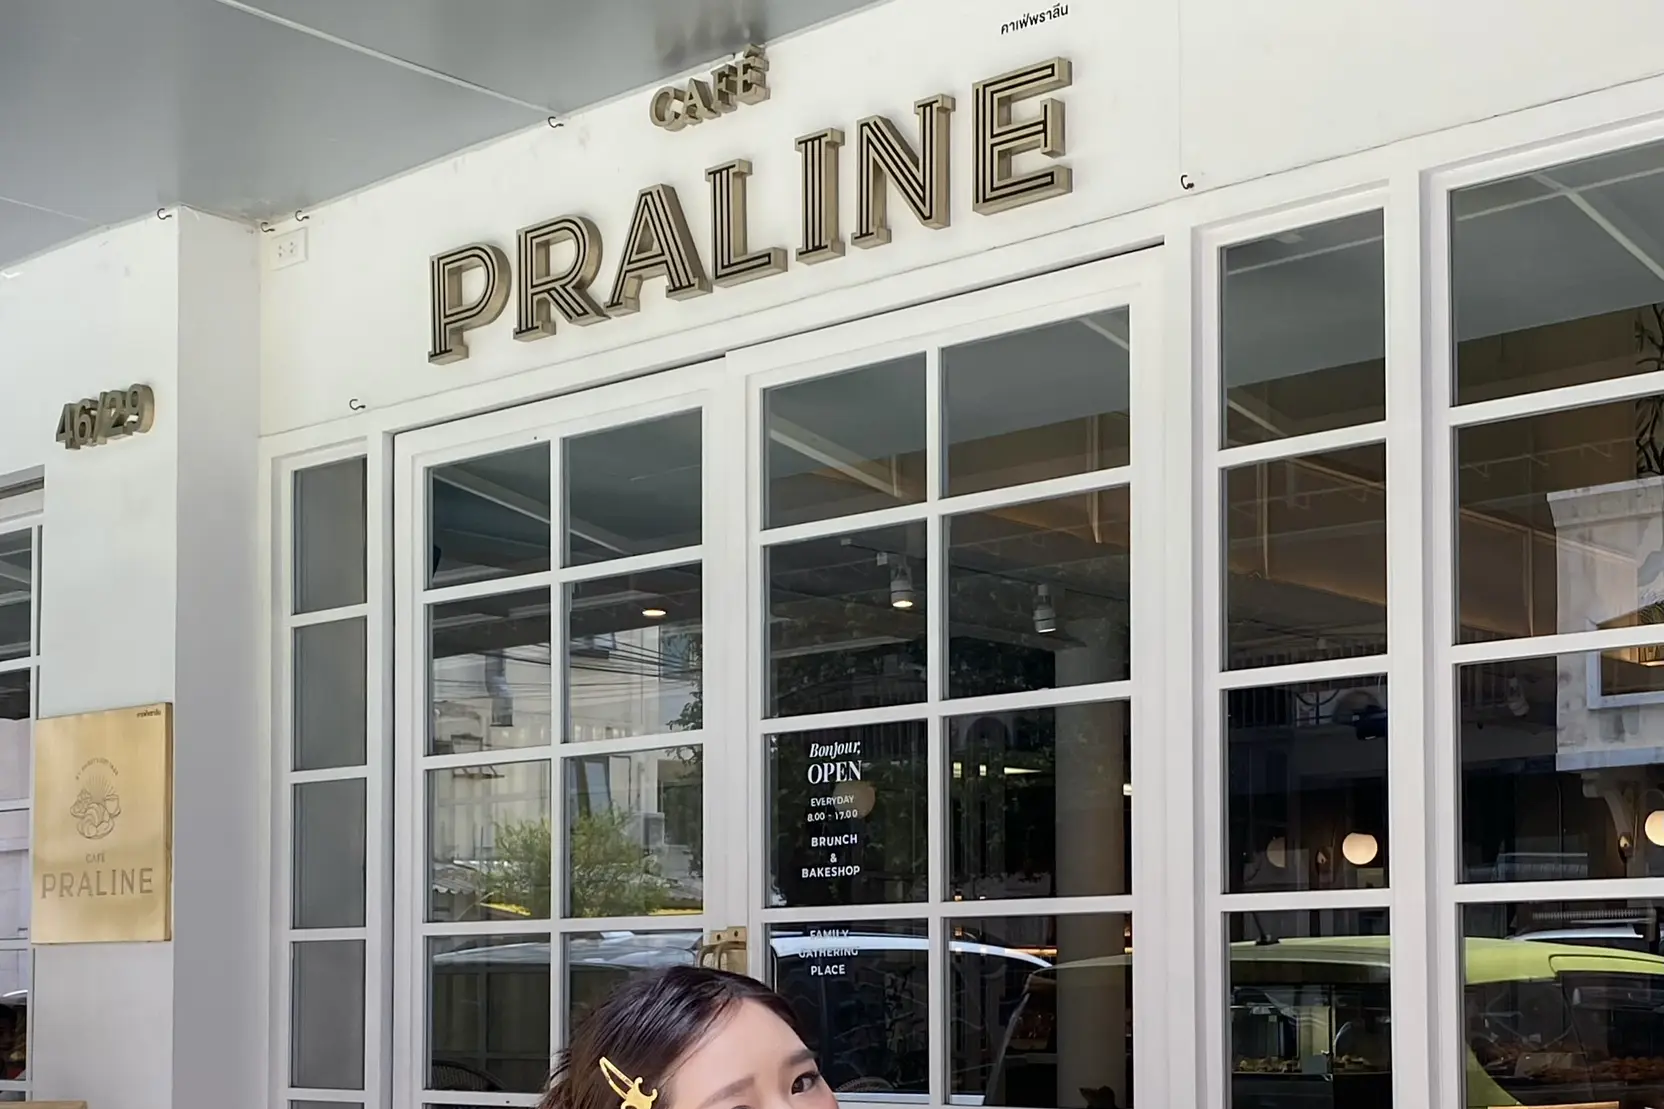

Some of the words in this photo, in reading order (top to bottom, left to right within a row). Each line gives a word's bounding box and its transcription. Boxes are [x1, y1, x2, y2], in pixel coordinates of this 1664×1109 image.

[649, 43, 771, 132] CAFÉ
[428, 57, 1073, 365] PRALINE
[56, 383, 155, 450] 46/29
[809, 741, 861, 759] Bonjour,
[807, 760, 862, 784] OPEN
[810, 795, 855, 807] EVERYDAY
[807, 812, 826, 822] 8.00
[834, 809, 858, 820] 17.00
[811, 834, 858, 847] BRUNCH
[830, 853, 837, 863] &
[801, 865, 861, 878] BAKESHOP
[41, 868, 153, 899] PRALINE
[810, 964, 846, 976] PLACE
